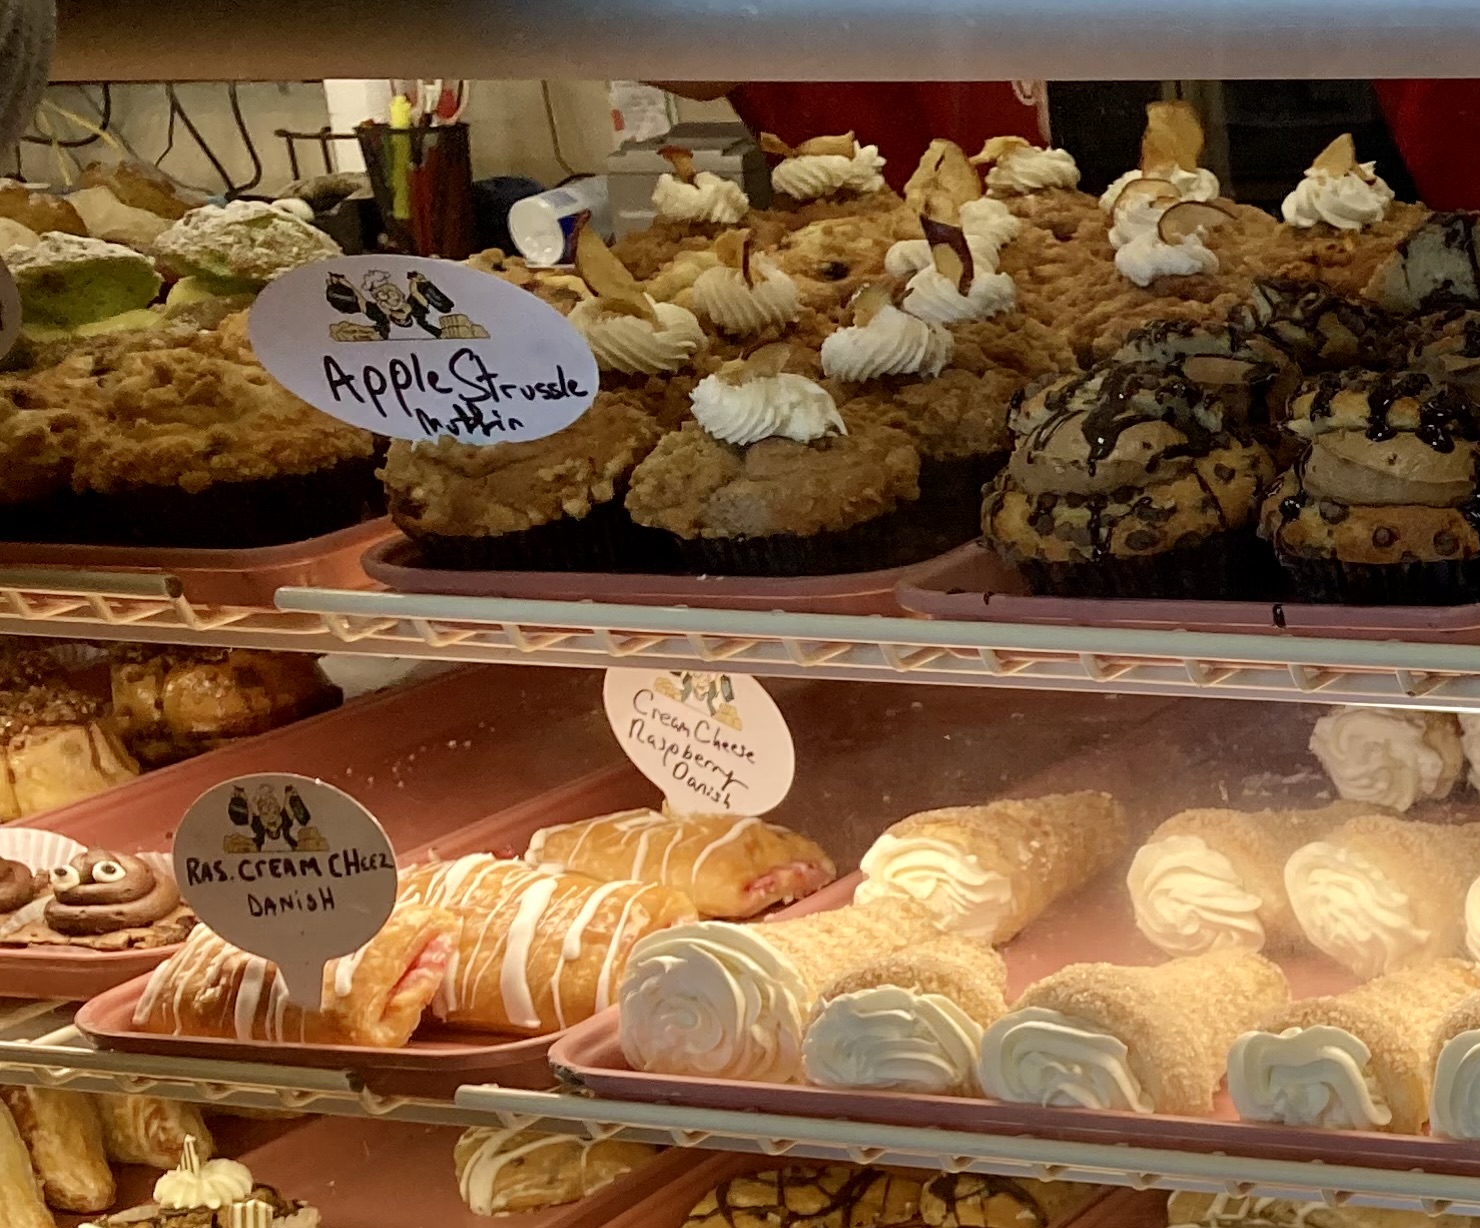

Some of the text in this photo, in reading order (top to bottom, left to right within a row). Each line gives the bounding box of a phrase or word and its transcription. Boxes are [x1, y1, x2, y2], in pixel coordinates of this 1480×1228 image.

[323, 352, 453, 418] Apple
[632, 688, 756, 765] Cream Cheese
[672, 761, 731, 810] Danish
